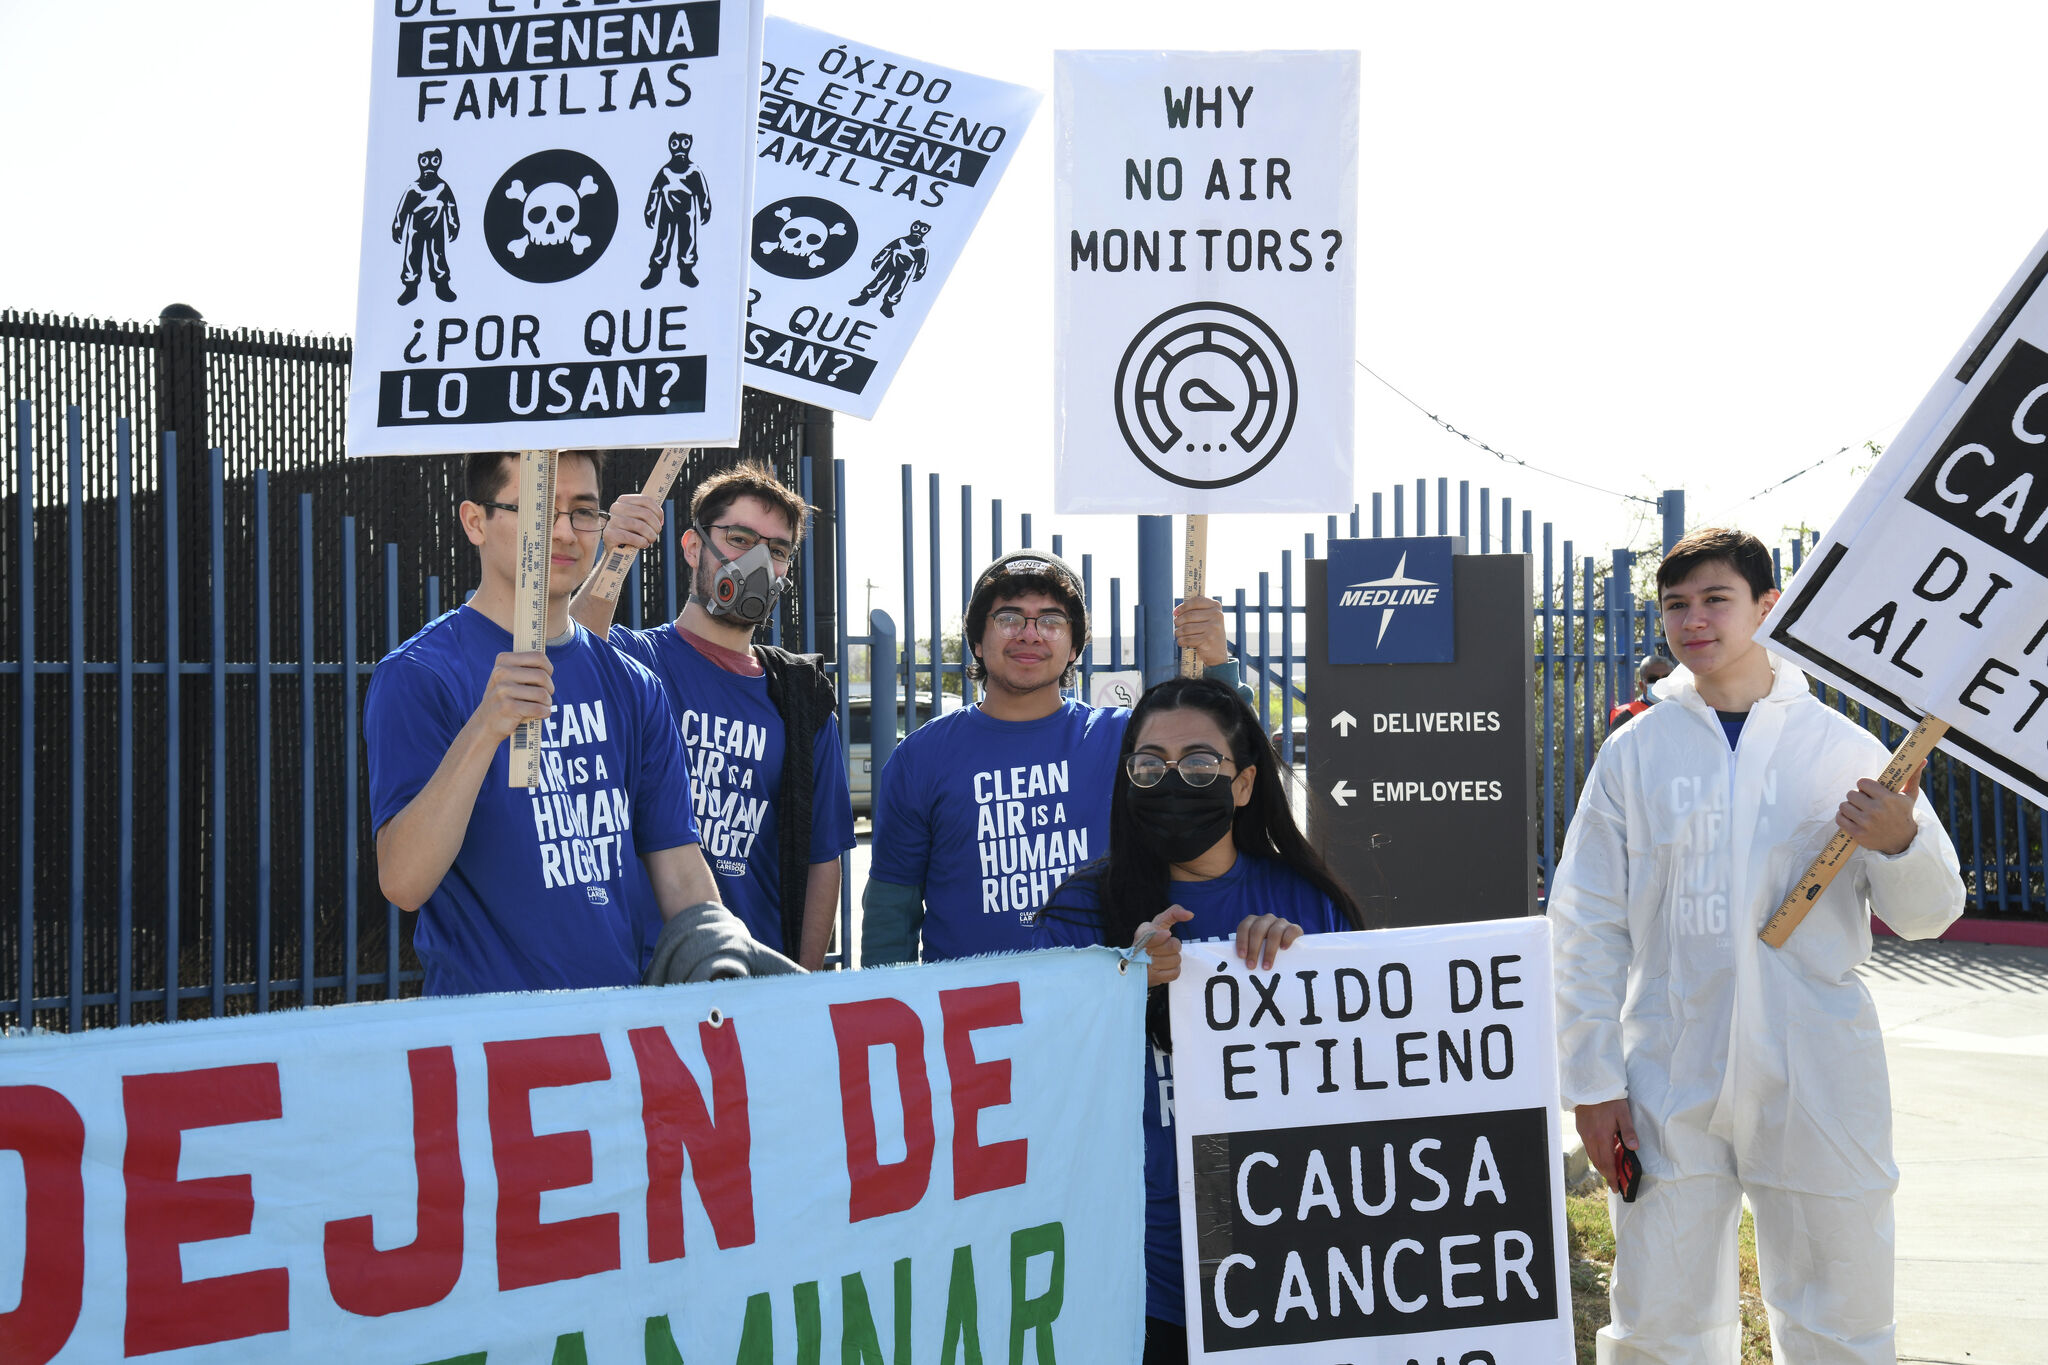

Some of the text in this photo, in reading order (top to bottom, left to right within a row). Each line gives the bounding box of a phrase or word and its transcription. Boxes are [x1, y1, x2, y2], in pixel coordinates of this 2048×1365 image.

[421, 9, 695, 70] ENVENENA
[417, 63, 692, 123] FAMILIAS
[818, 44, 952, 104] ÓXIDO
[760, 60, 1007, 153] DE ETILENO
[1163, 85, 1254, 130] WHY
[758, 96, 962, 179] ENVENENA
[757, 130, 949, 208] AMILIAS
[1125, 157, 1293, 201] NO AIR
[1070, 228, 1343, 273] MONITORS?
[403, 305, 688, 364] ¿POR QUE
[744, 329, 854, 382] SAN?
[788, 305, 878, 352] QUE
[399, 362, 681, 419] LO USAN?
[1934, 442, 2048, 545] CA
[526, 563, 532, 572] UP
[1912, 546, 2013, 629] DI
[1338, 588, 1440, 607] MEDLINE
[1847, 600, 1929, 679] AL
[1959, 658, 2048, 742] ET
[541, 699, 608, 748] LEAN
[681, 709, 767, 761] CLEAN
[1373, 711, 1501, 733] DELIVERIES
[567, 756, 589, 785] IS
[595, 754, 609, 781] A
[740, 768, 753, 790] A
[973, 760, 1069, 804] CLEAN
[1372, 780, 1502, 802] EMPLOYEES
[531, 787, 630, 842] HUMAN
[977, 801, 1067, 841] AIR IS A
[539, 834, 623, 889] RIGHT!
[978, 827, 1089, 878] HUMAN
[982, 865, 1076, 914] RIGHT
[1678, 894, 1727, 936] RIG
[1204, 955, 1524, 1031] ÓXIDO DE
[1222, 1023, 1514, 1100] ETILENO
[829, 981, 1028, 1224] DE
[1236, 1135, 1507, 1226] CAUSA
[1213, 1229, 1539, 1329] CANCER
